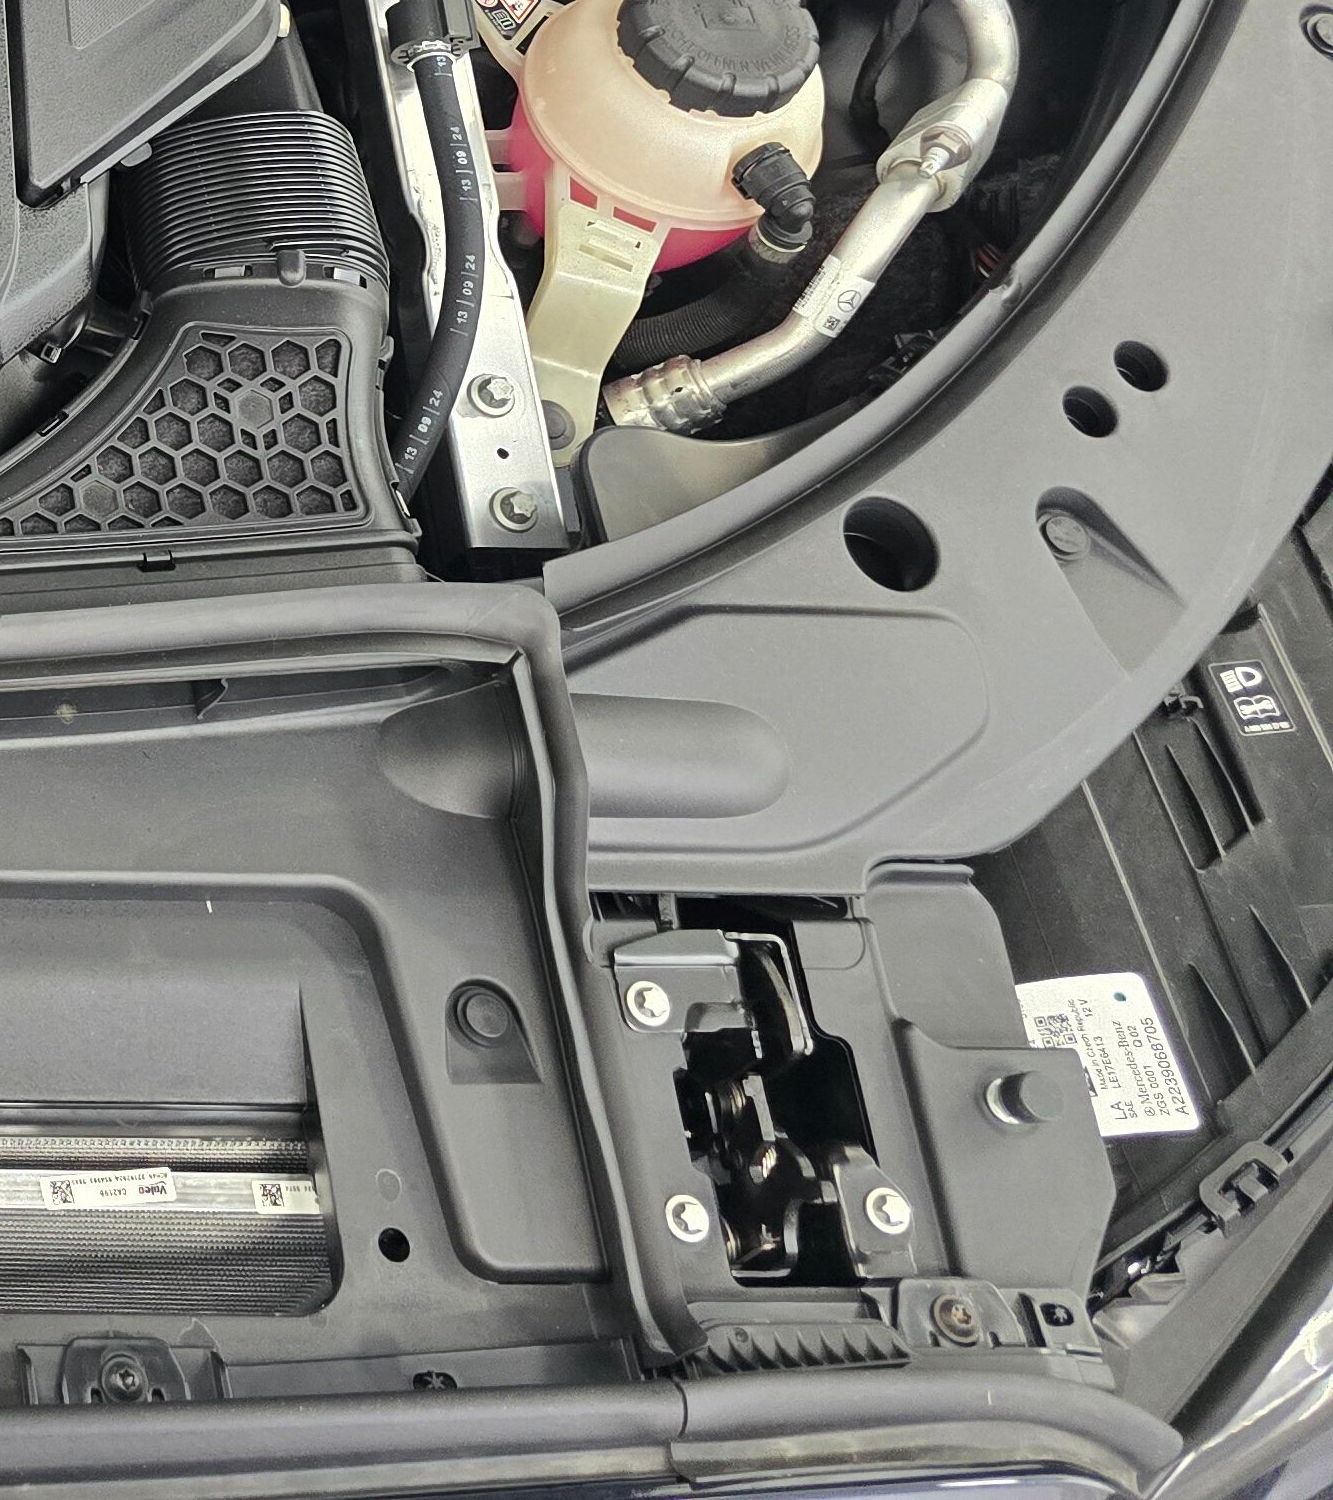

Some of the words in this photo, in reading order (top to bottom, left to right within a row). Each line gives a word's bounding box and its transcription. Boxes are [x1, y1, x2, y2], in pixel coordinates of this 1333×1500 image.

[449, 126, 463, 141] 24
[456, 150, 469, 166] 09
[461, 178, 473, 193] 13
[463, 254, 478, 271] 24
[461, 280, 476, 297] 09
[455, 309, 470, 325] 13
[403, 446, 419, 461] 13
[416, 416, 433, 434] 09
[427, 388, 444, 406] 24
[1067, 998, 1089, 1032] Republic
[1083, 1007, 1094, 1018] 12
[1126, 1024, 1139, 1038] 02
[1079, 1032, 1097, 1058] Czech
[1132, 1039, 1144, 1048] Q
[1093, 1035, 1122, 1089] LE17E6413
[1110, 1019, 1153, 1105] Mercedes-Benz
[1140, 1016, 1191, 1116] A2239068705
[1094, 1068, 1109, 1091] Made
[1142, 1064, 1160, 1089] 0001
[1110, 1100, 1128, 1121] LA
[1124, 1099, 1139, 1119] SAE
[1152, 1091, 1171, 1117] ZGS
[138, 1185, 167, 1195] Valeo
